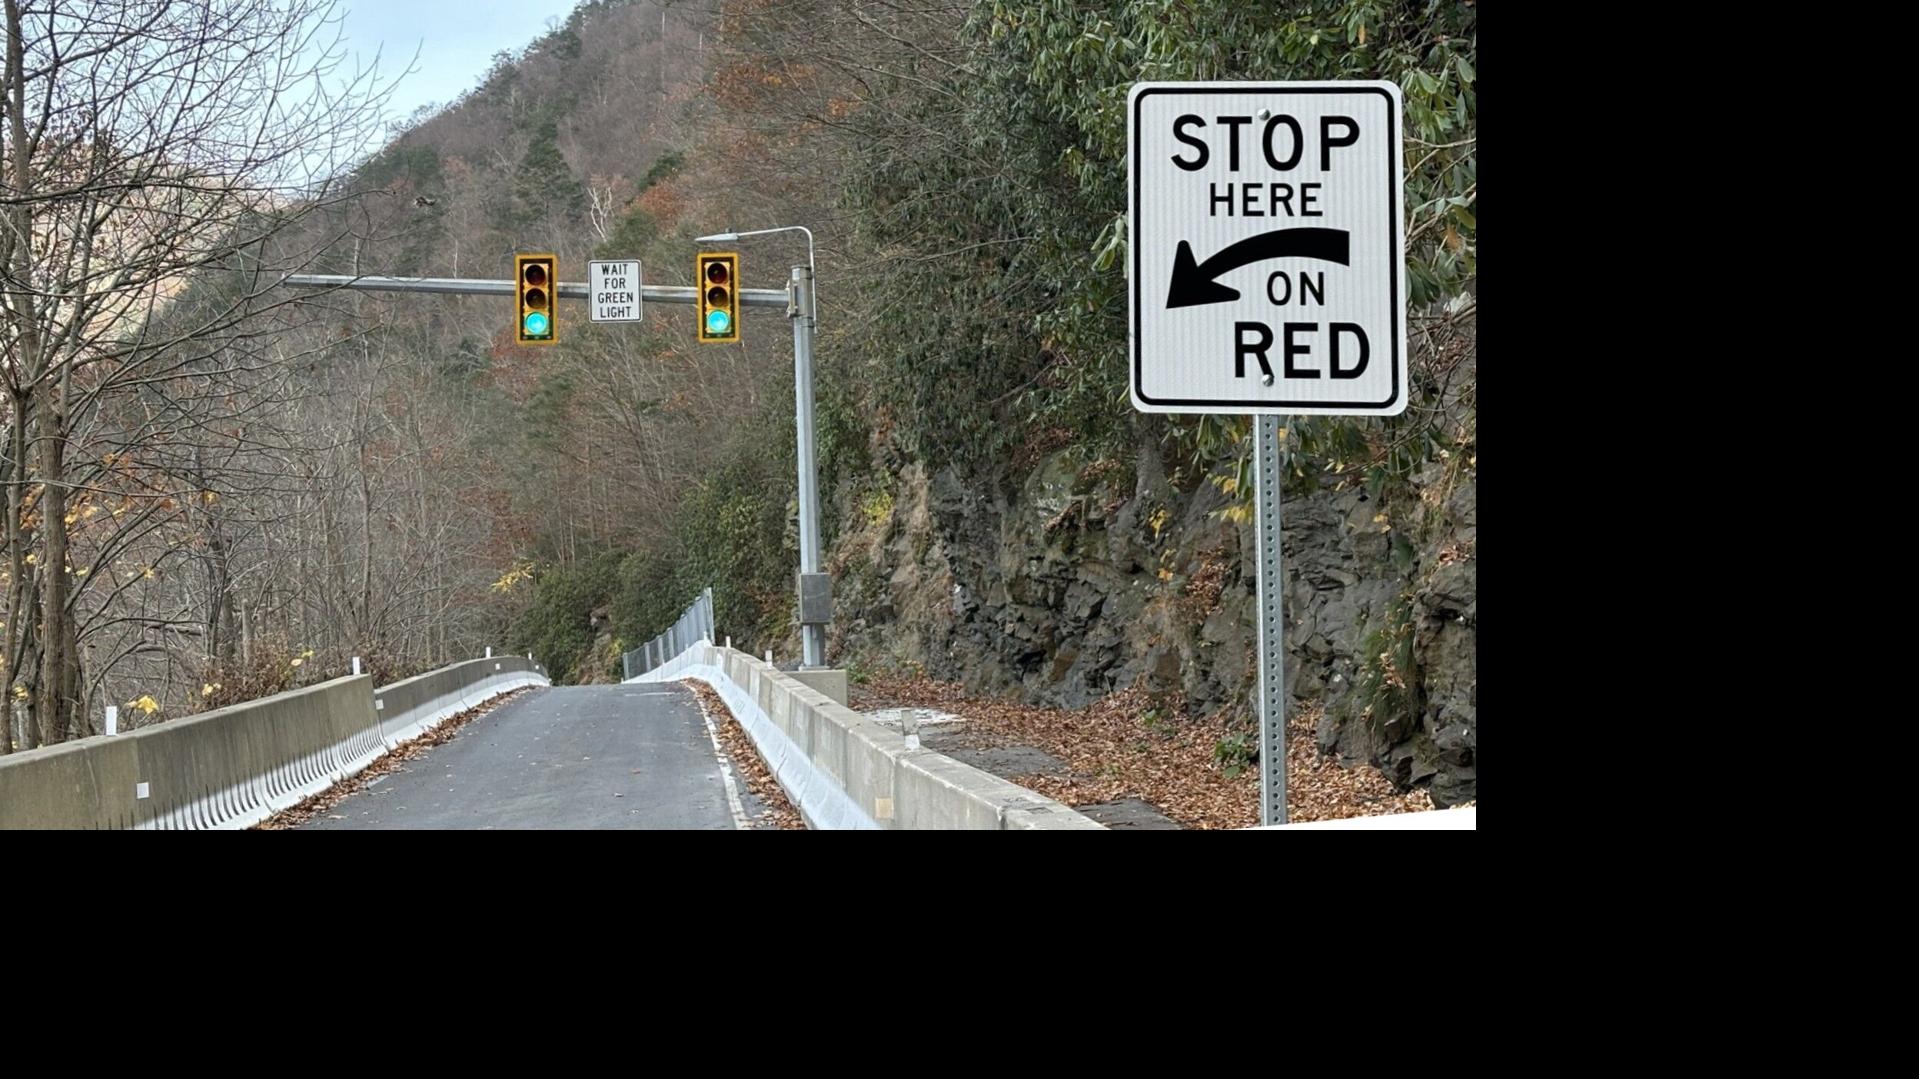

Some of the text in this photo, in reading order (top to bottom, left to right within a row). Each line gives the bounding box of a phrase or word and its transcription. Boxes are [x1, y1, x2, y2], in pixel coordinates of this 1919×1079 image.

[1170, 114, 1360, 171] STOP
[1209, 183, 1323, 217] HERE
[601, 264, 628, 275] WAIT
[604, 278, 626, 289] FOR
[1267, 271, 1325, 306] ON
[597, 292, 633, 304] GREEN
[600, 306, 631, 318] LIGHT
[1234, 321, 1370, 380] RED
